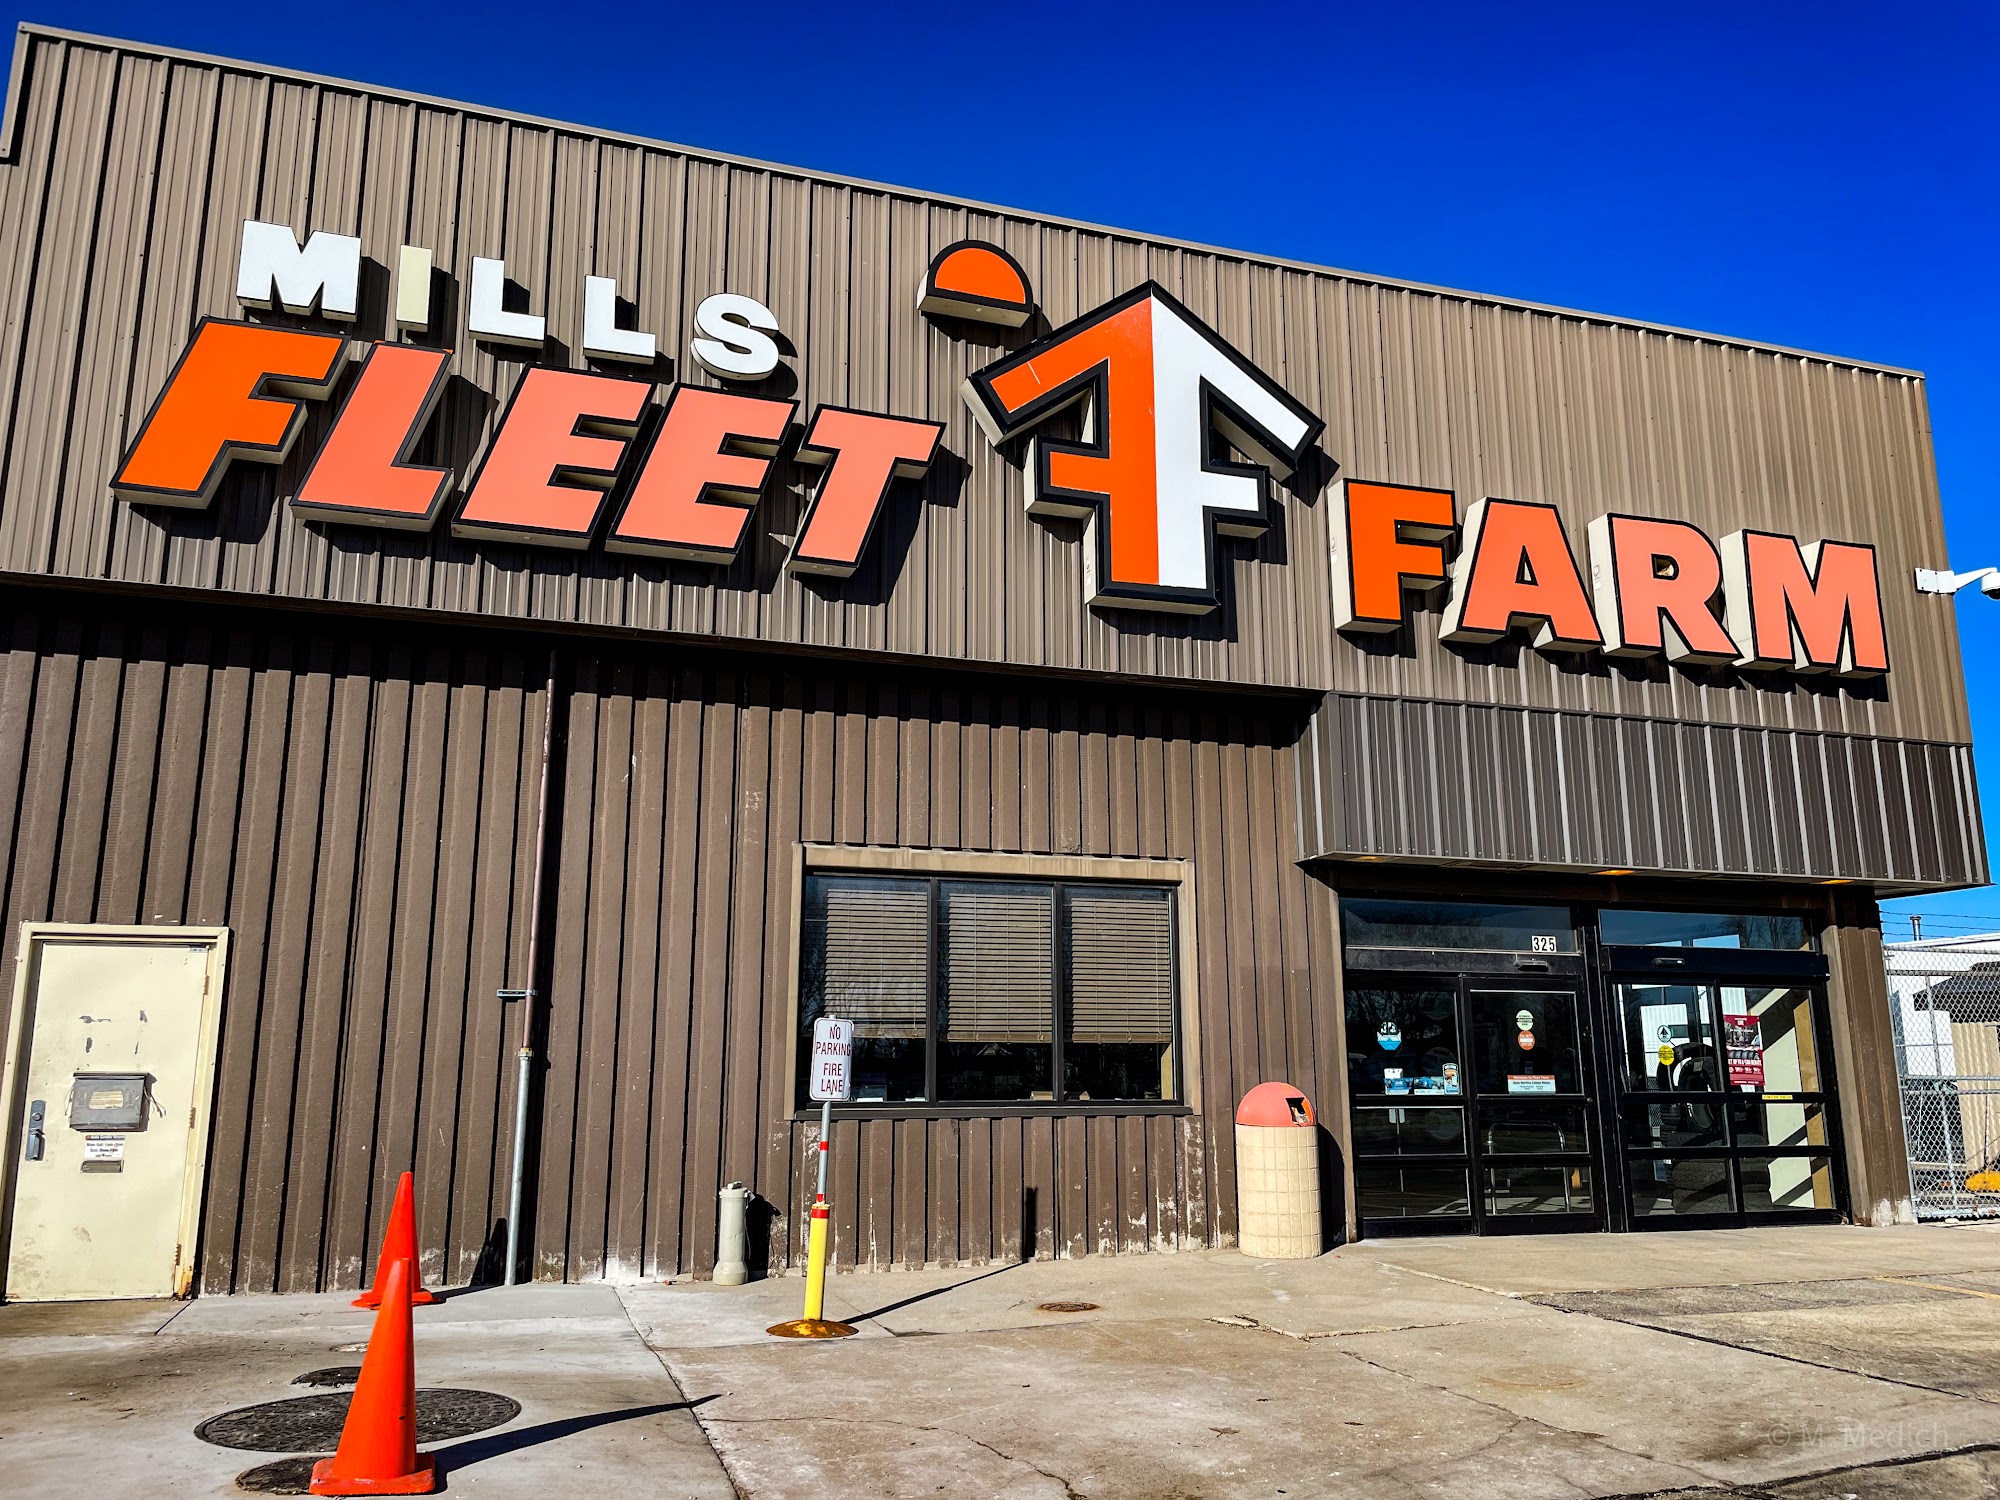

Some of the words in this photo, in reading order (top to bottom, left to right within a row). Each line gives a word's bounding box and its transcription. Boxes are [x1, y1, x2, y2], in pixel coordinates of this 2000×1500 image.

[237, 219, 780, 381] MILLS
[109, 315, 947, 577] FLEET
[1332, 478, 1890, 677] FARM
[1533, 936, 1555, 952] 325
[829, 1026, 841, 1040] NO
[815, 1041, 851, 1057] PARKING
[823, 1062, 842, 1077] FIRE
[820, 1079, 843, 1093] LANE
